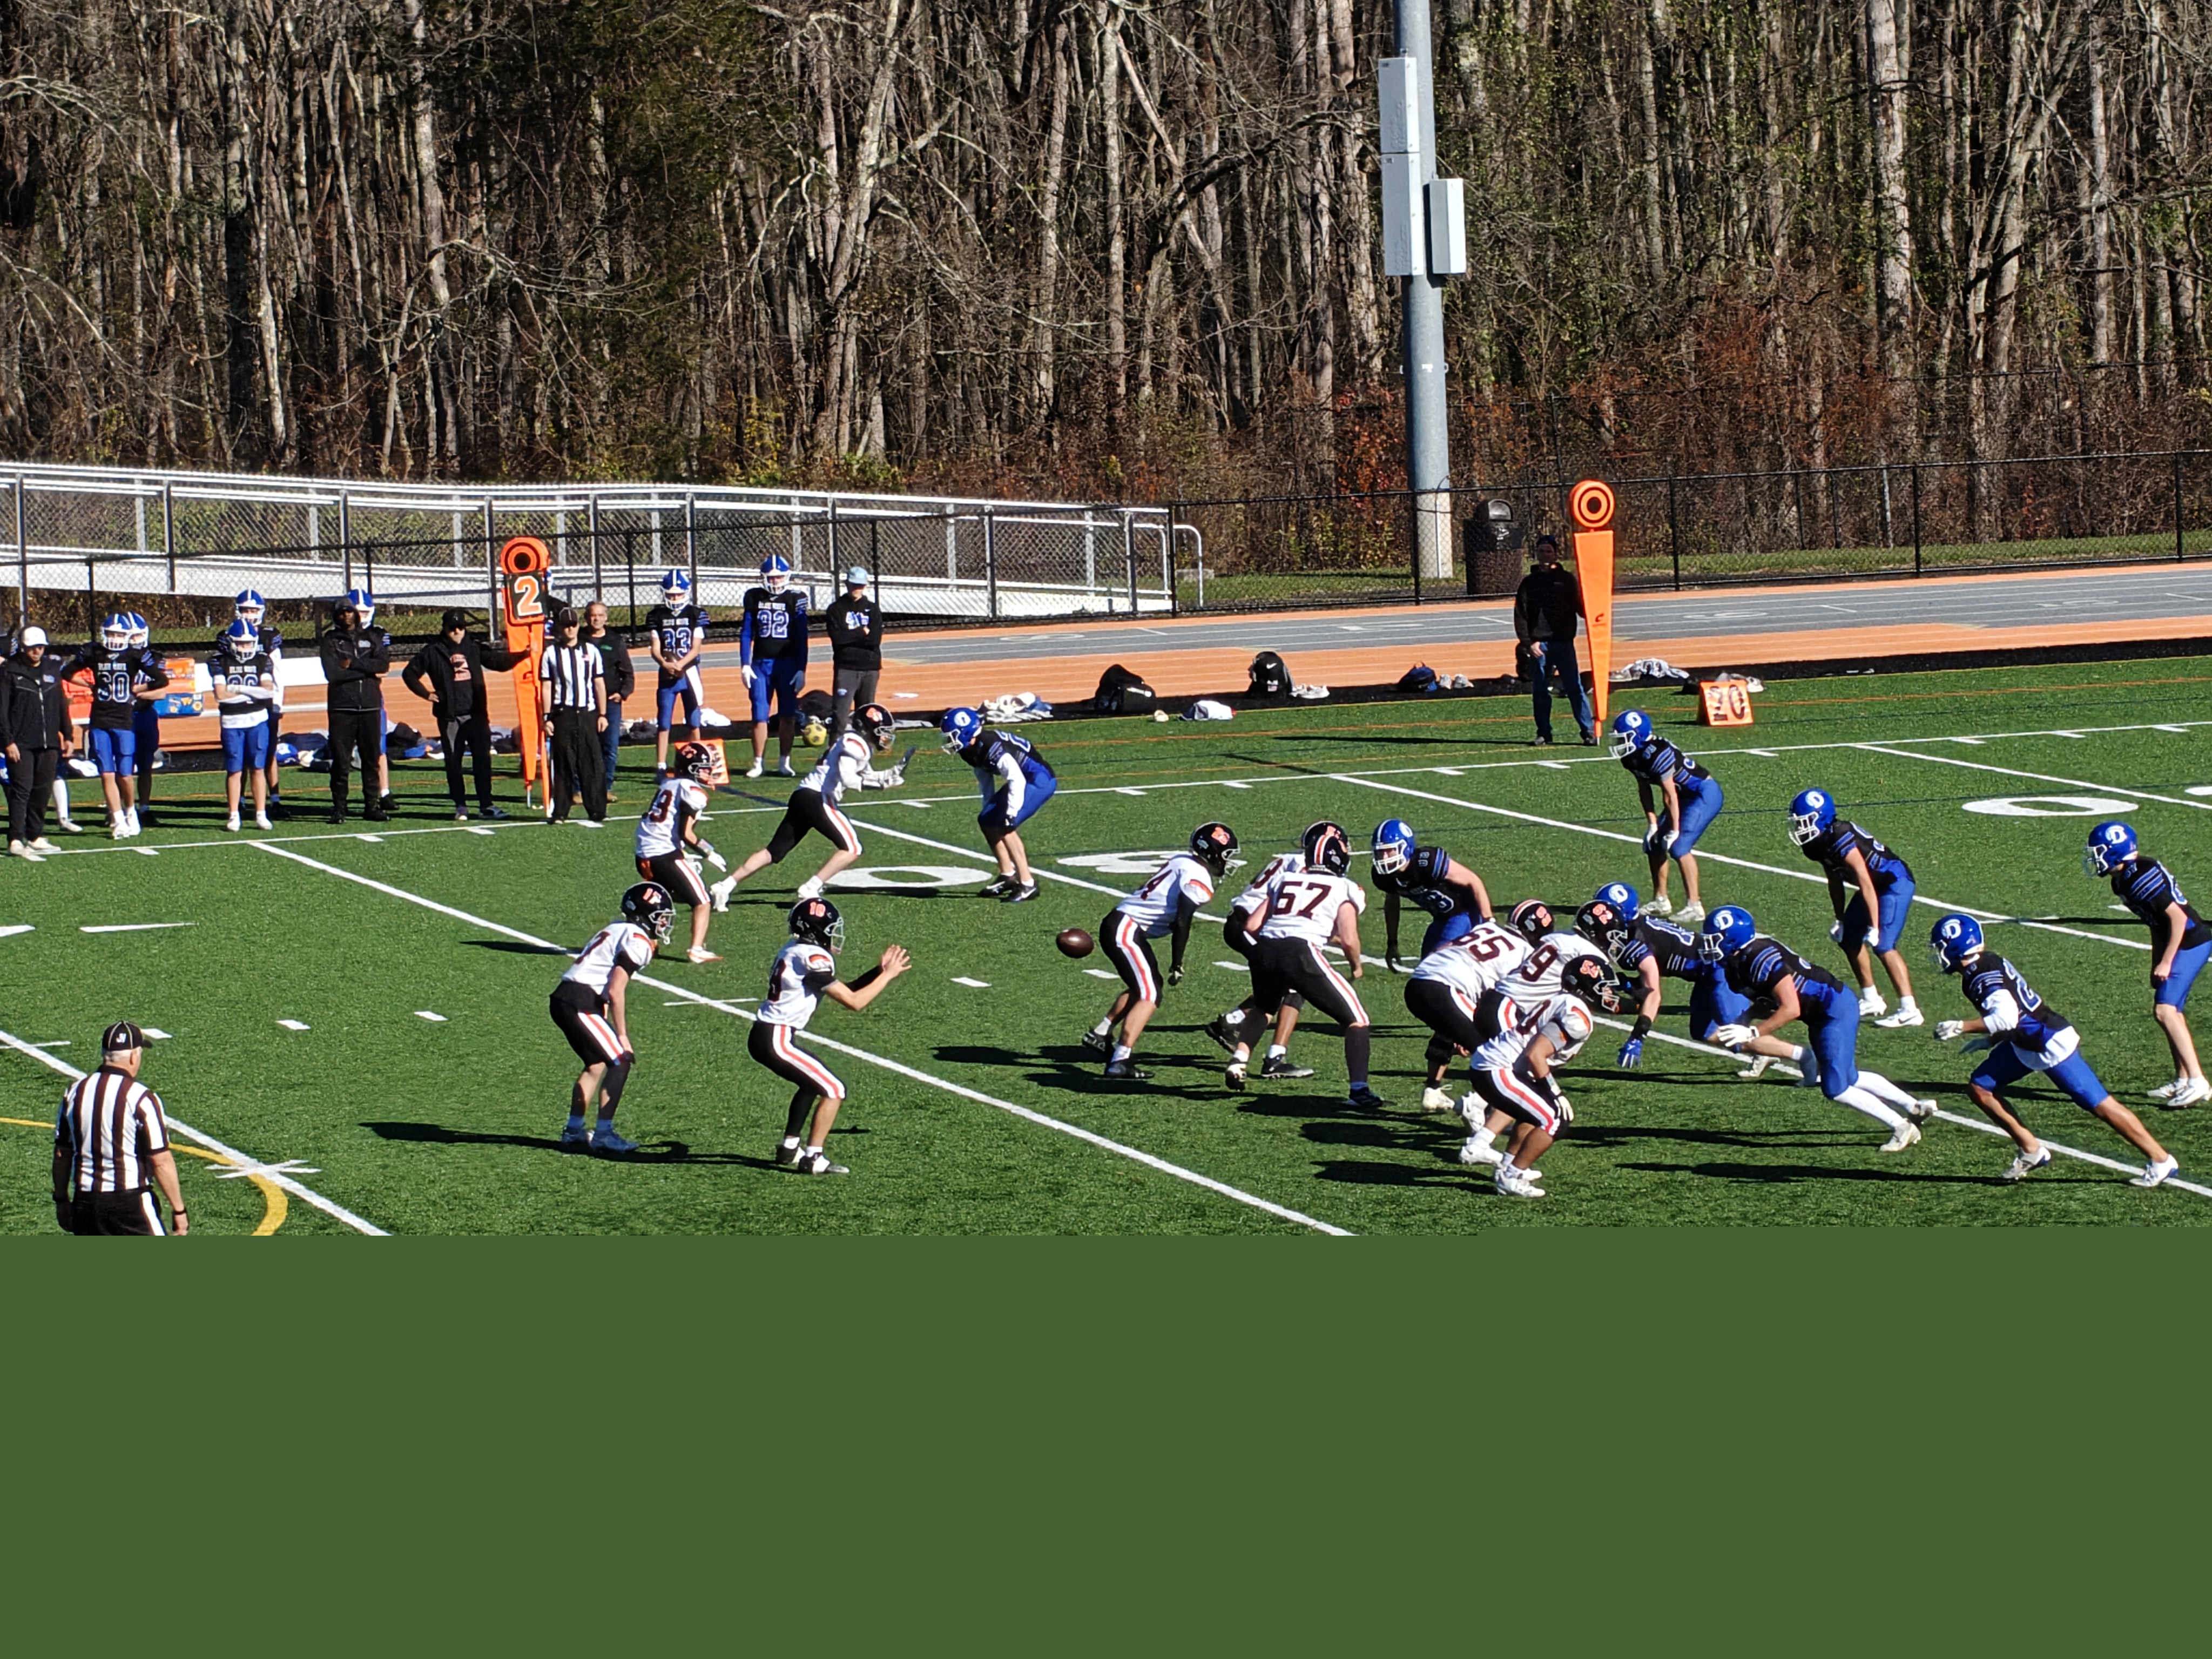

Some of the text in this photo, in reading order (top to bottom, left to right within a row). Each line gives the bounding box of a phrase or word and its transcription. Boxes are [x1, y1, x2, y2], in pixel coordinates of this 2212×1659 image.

[514, 575, 543, 616] 2
[1709, 684, 1745, 720] 20
[1272, 881, 1332, 920] 67
[1452, 927, 1516, 962] 65
[1521, 944, 1558, 982] 9
